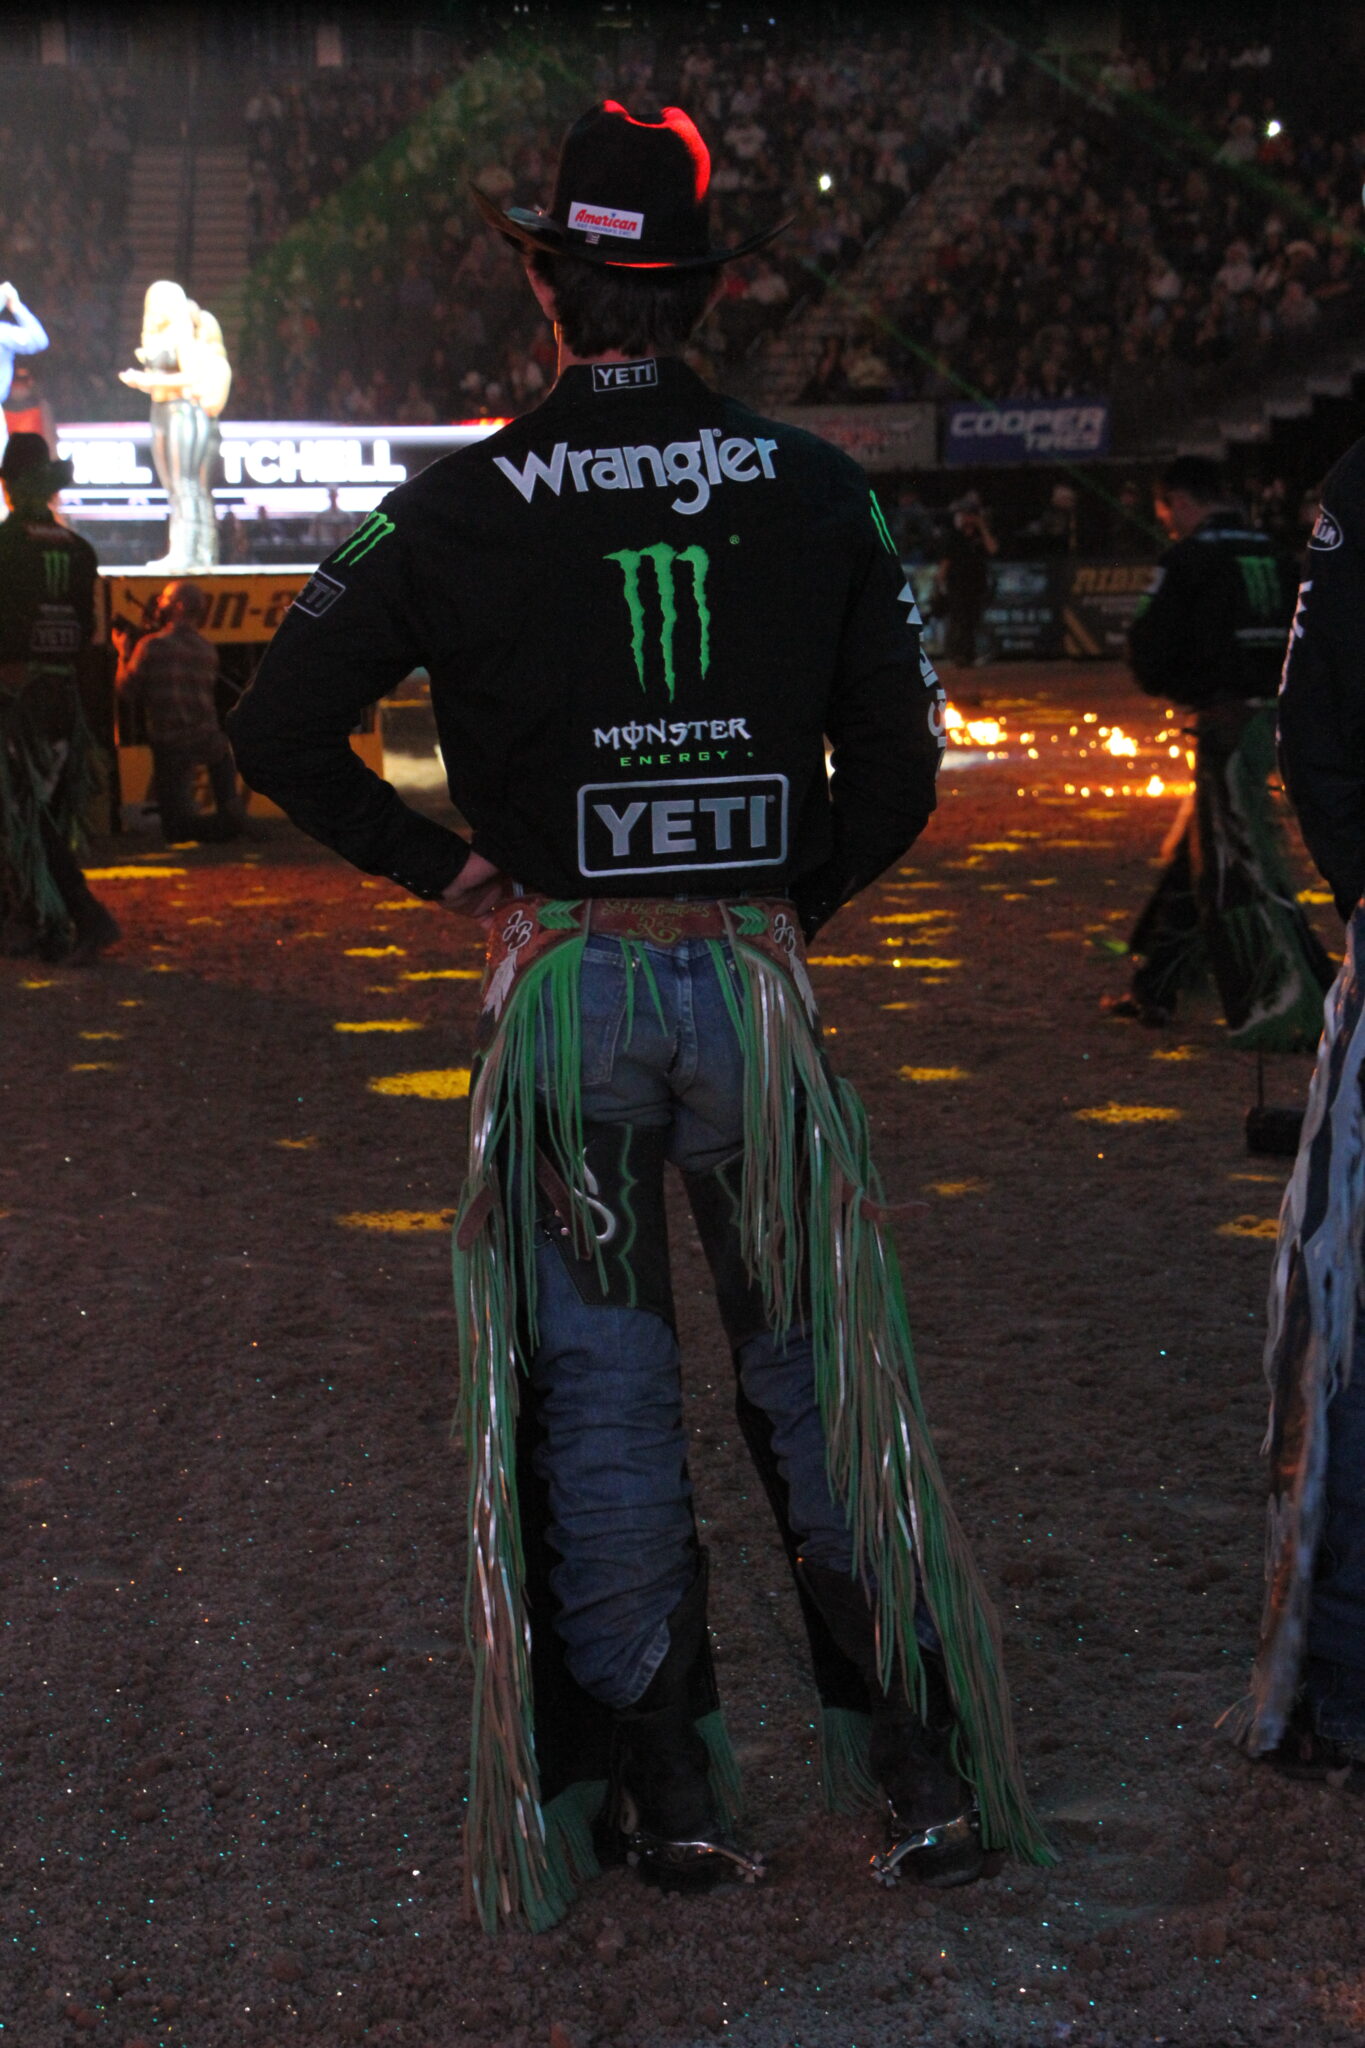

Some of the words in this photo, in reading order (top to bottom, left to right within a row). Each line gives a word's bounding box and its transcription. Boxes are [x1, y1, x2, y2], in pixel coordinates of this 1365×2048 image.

[596, 363, 652, 387] YETI
[491, 428, 779, 516] Wrangler
[592, 717, 753, 751] MONSTER
[619, 750, 730, 768] ENERGY
[592, 794, 768, 857] YETI
